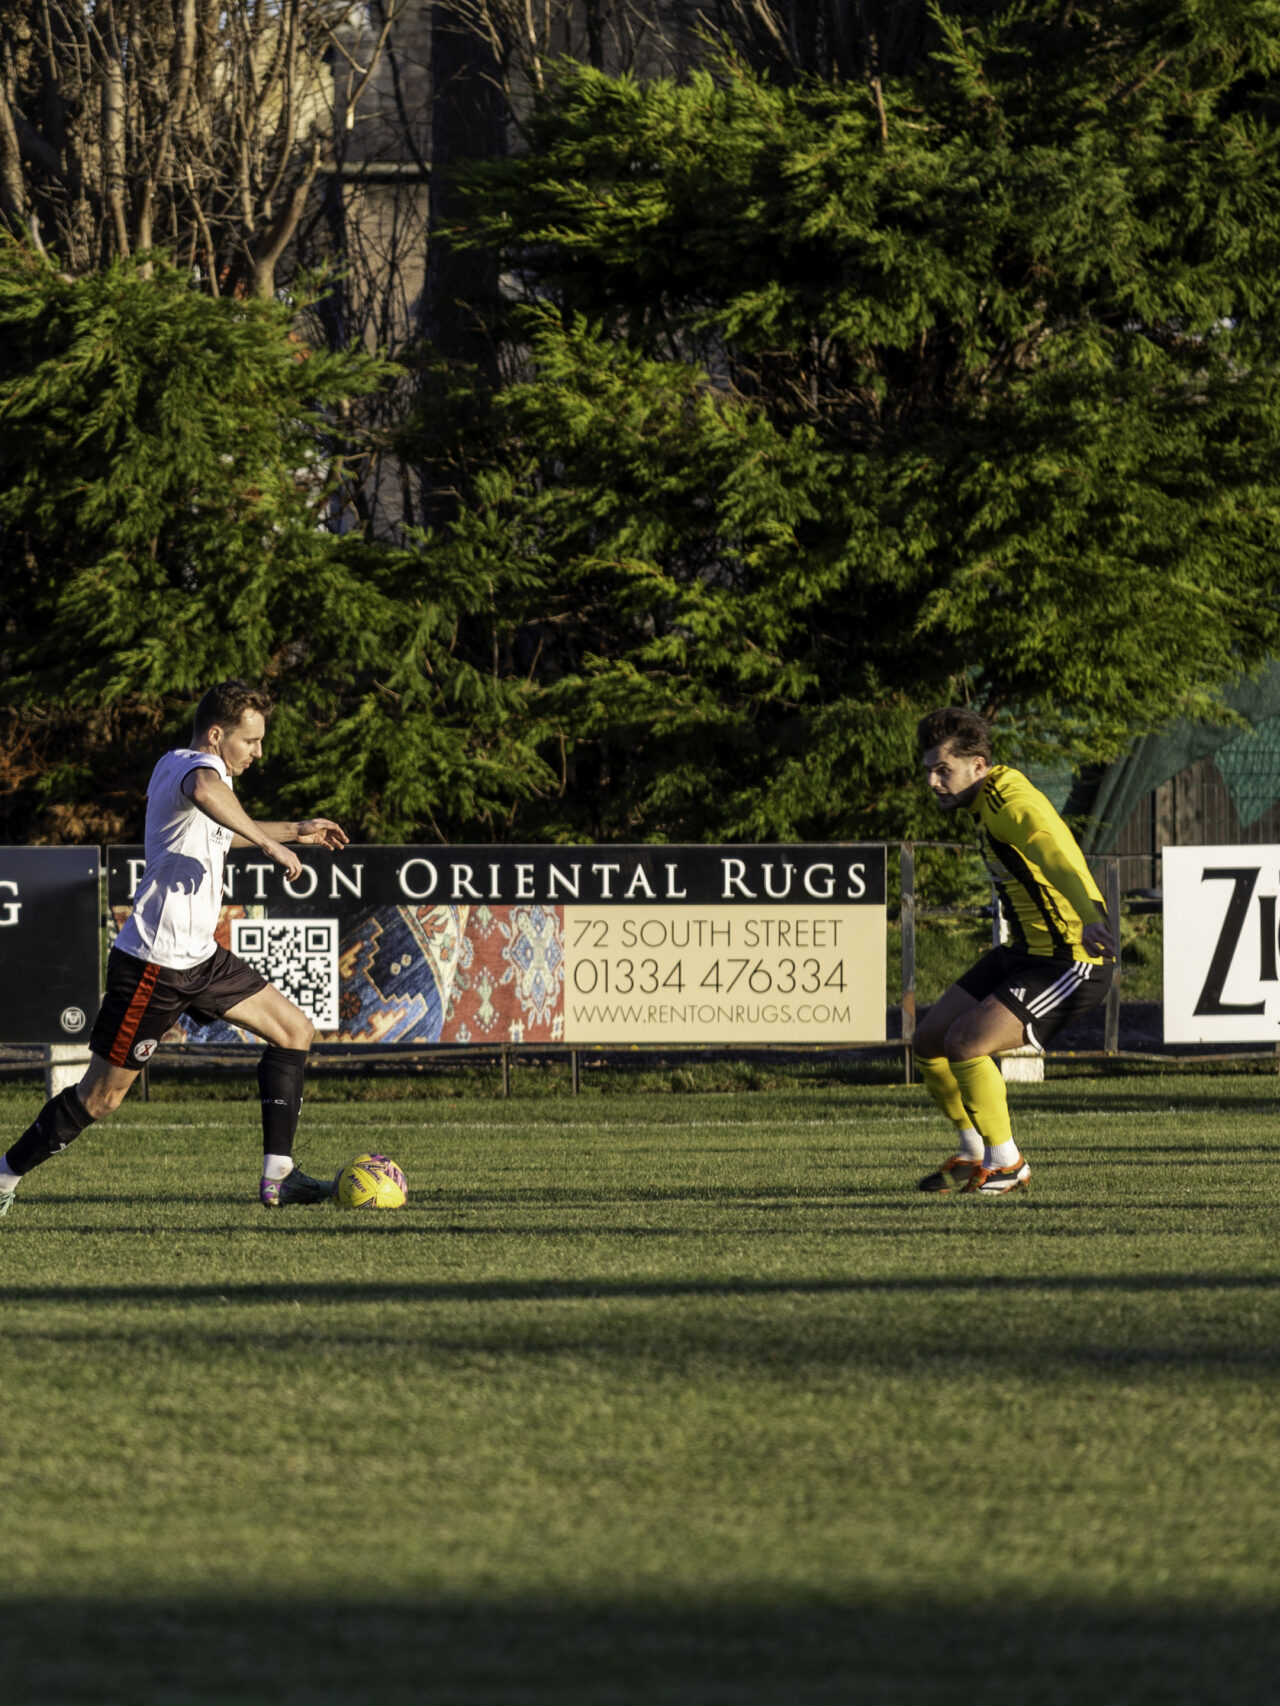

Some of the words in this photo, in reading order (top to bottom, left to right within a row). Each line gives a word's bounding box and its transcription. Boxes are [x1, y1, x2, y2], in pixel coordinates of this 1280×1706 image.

[126, 858, 364, 900] RNTON
[398, 858, 687, 899] ORIENTAL
[721, 858, 866, 899] RUGS
[573, 919, 609, 948] 72
[621, 919, 731, 948] SOUTH
[743, 919, 844, 948] STREET
[573, 958, 686, 995] 01334
[699, 958, 848, 995] 476334
[572, 1004, 853, 1024] WWW.RENTONRUGS.COM
